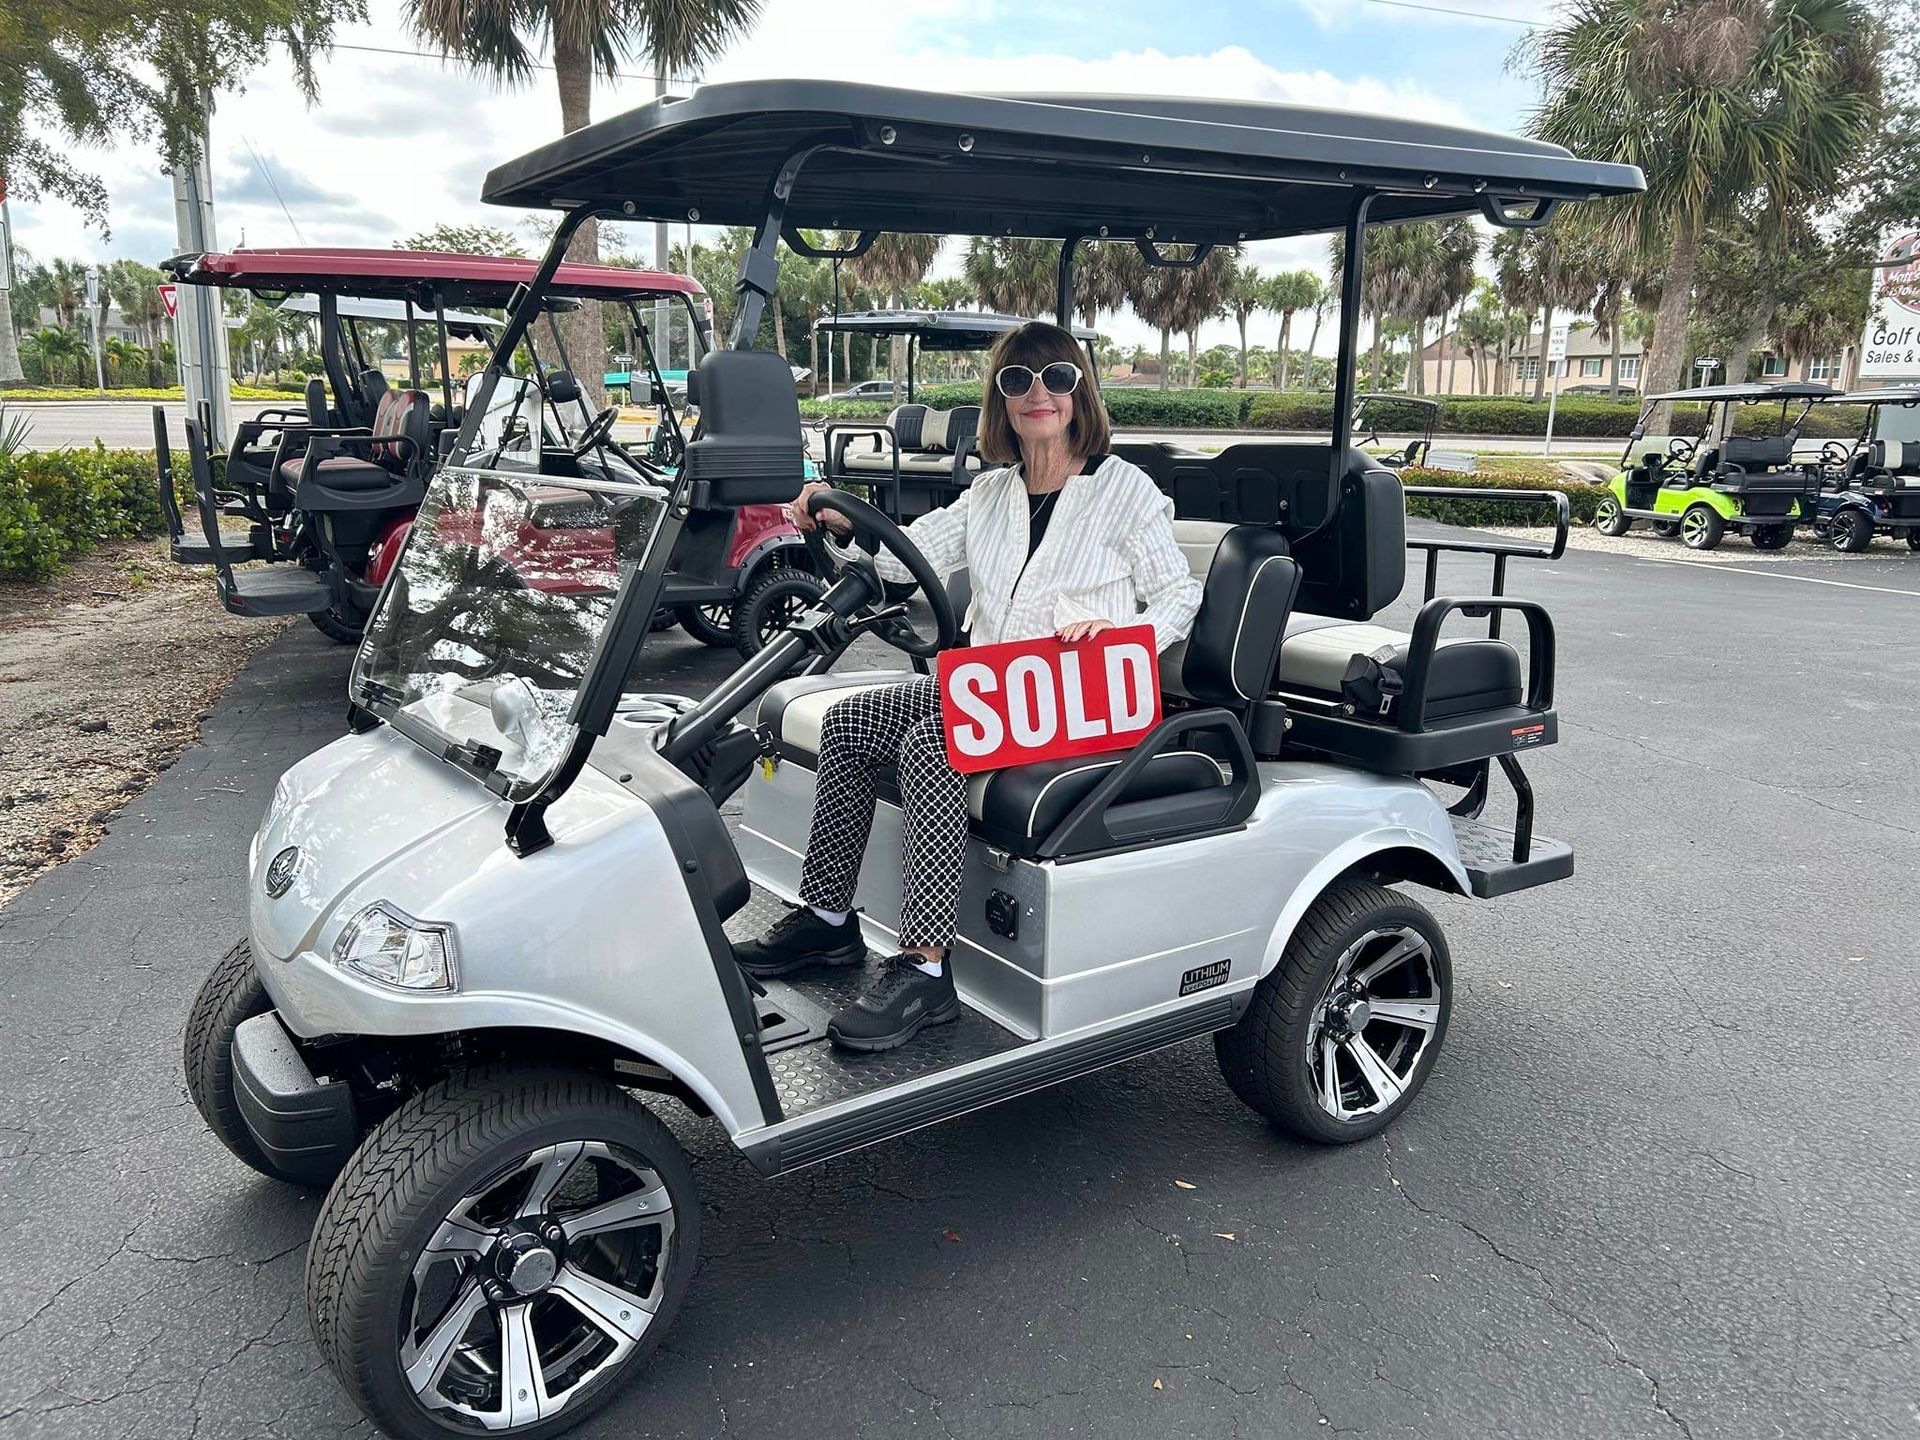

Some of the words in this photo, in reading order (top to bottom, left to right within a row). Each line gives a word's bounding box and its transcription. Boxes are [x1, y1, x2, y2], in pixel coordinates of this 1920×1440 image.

[1872, 326, 1915, 346] Golf
[1865, 350, 1900, 364] Sales
[1904, 350, 1914, 363] &
[948, 643, 1155, 756] SOLD
[1184, 960, 1229, 984] LITHIUM
